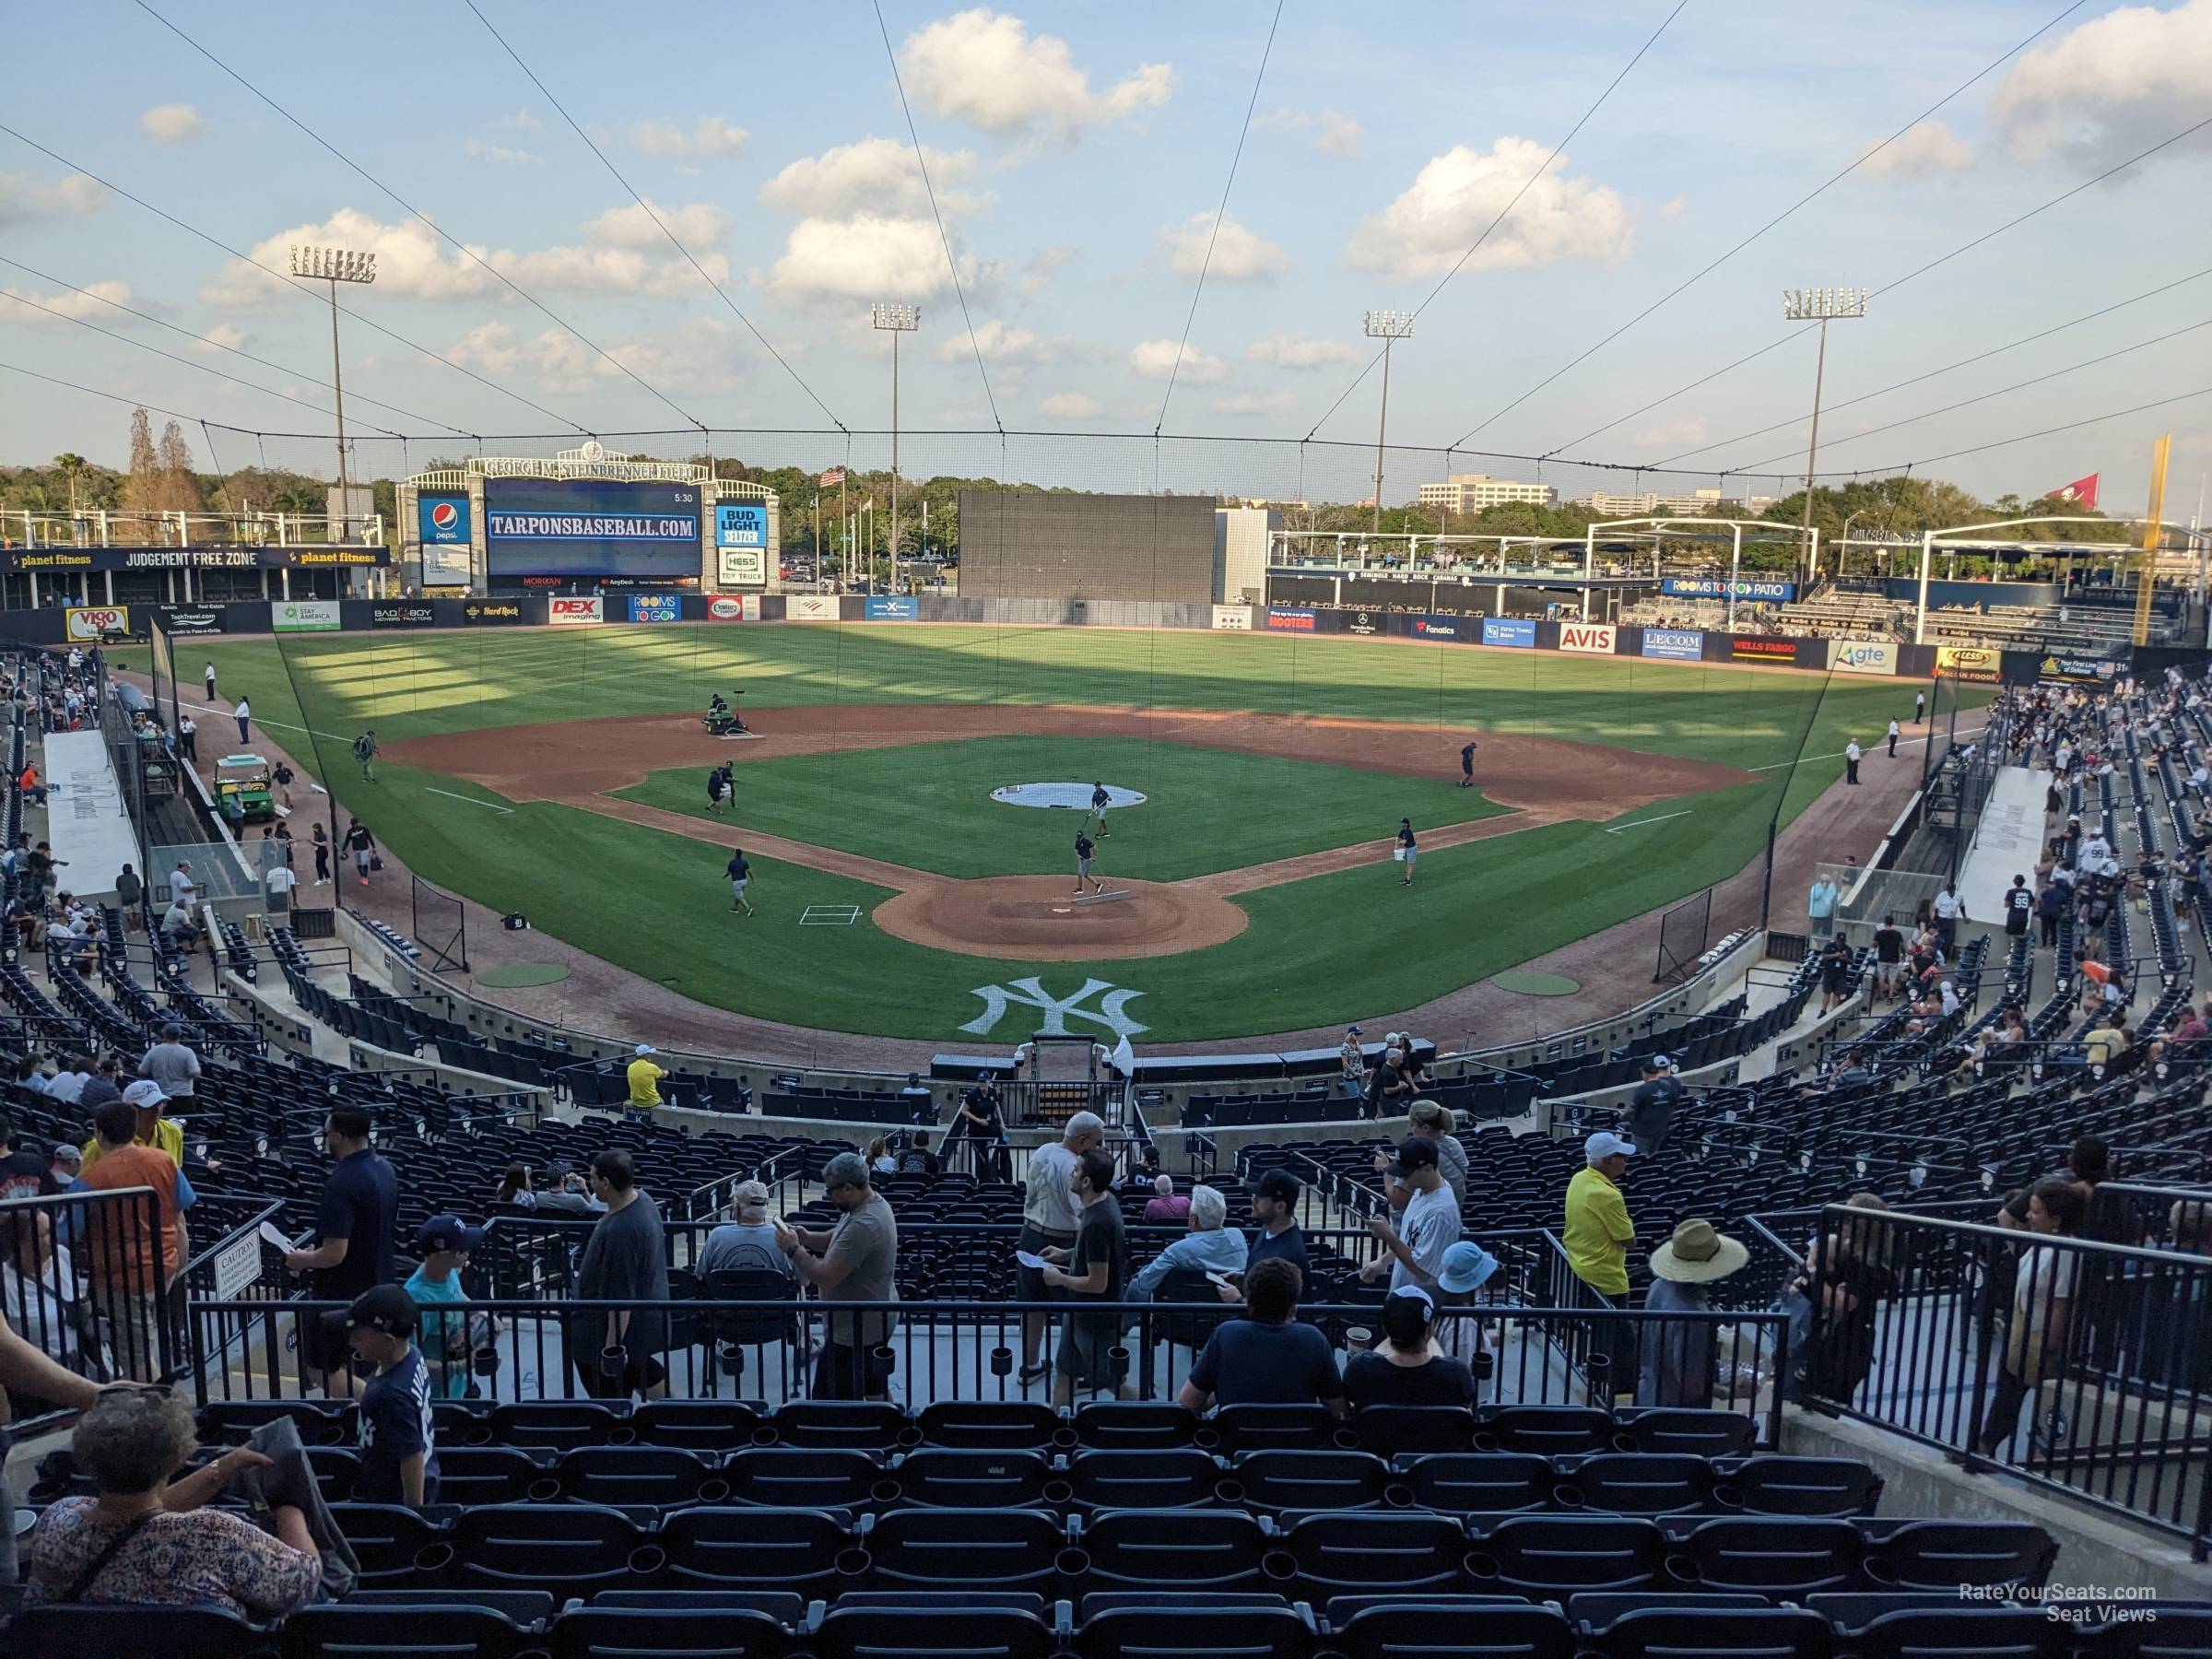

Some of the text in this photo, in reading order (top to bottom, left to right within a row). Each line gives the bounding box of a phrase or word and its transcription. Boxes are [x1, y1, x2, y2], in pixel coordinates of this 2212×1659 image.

[488, 461, 542, 475] GEORGE
[561, 463, 657, 477] STEINBRENNER
[660, 466, 694, 478] FIELD
[675, 494, 693, 502] 5:30
[726, 510, 756, 521] BUD
[491, 516, 693, 537] TARPONSBASEBALL.COM
[721, 521, 761, 531] LIGHT
[436, 532, 458, 540] pepsi
[724, 530, 759, 544] SELTZER
[21, 554, 91, 568] planet fitness
[126, 552, 257, 567] JUDGEMENT FREE ZONE
[300, 553, 376, 565] planet fitness
[729, 558, 756, 566] HESS
[1673, 581, 1712, 592] ROOMS
[1712, 582, 1726, 593] TO
[1754, 584, 1783, 596] PATIO
[552, 600, 596, 614] DEX
[634, 596, 676, 607] ROOMS
[374, 608, 432, 618] BAD BOY
[483, 606, 501, 617] Hard
[501, 606, 519, 617] Rock
[713, 604, 738, 613] Century
[563, 613, 601, 621] Imaging
[635, 610, 669, 621] TO GO
[1268, 617, 1313, 629] HOOTERS
[1426, 625, 1454, 634] Fanatics
[1561, 629, 1610, 649] AVIS
[1645, 633, 1700, 647] LECOM
[1733, 641, 1795, 653] WELLS FARGO
[1854, 647, 1885, 664] gte
[1970, 672, 1996, 680] FOODS
[2091, 849, 2104, 858] 99
[2014, 898, 2028, 908] 99
[958, 976, 1152, 1037] NY
[1571, 1108, 1578, 1118] G
[221, 1239, 254, 1269] CAUTION
